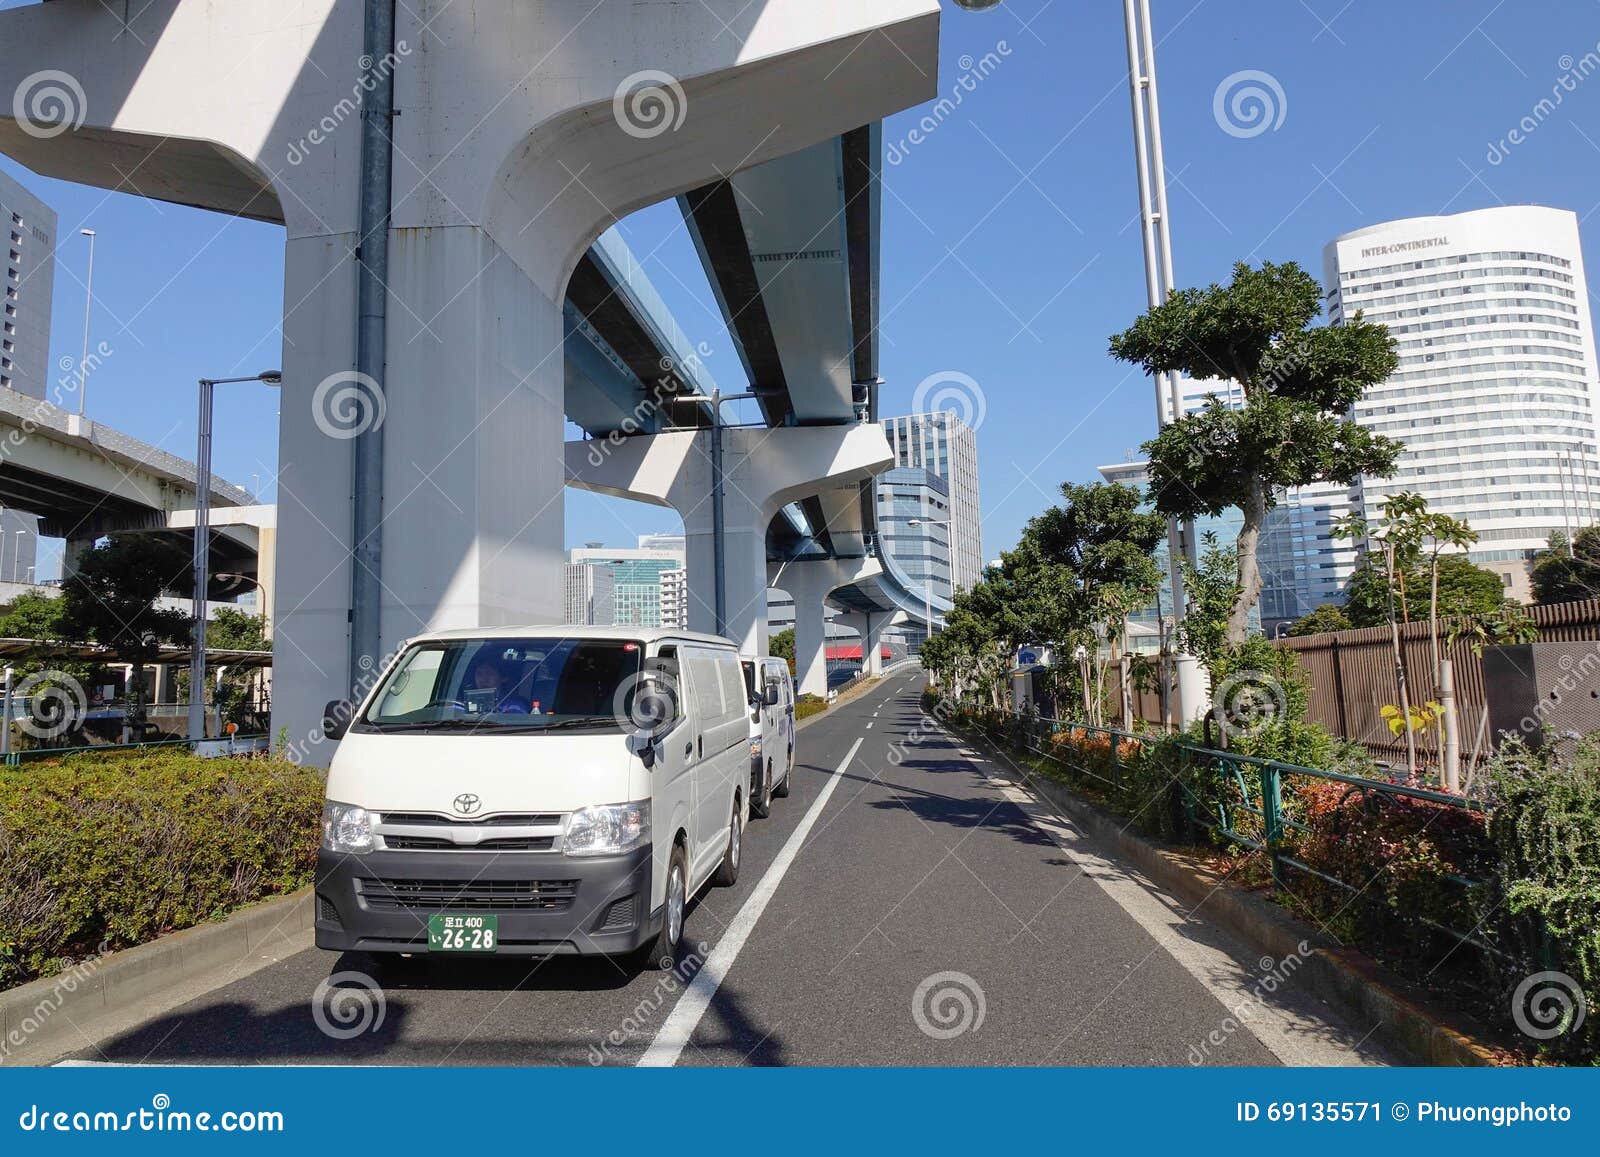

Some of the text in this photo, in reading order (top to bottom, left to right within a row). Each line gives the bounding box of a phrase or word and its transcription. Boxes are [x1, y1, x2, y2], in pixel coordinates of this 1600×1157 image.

[444, 917, 483, 928] 足立 400
[442, 928, 493, 949] 26-28
